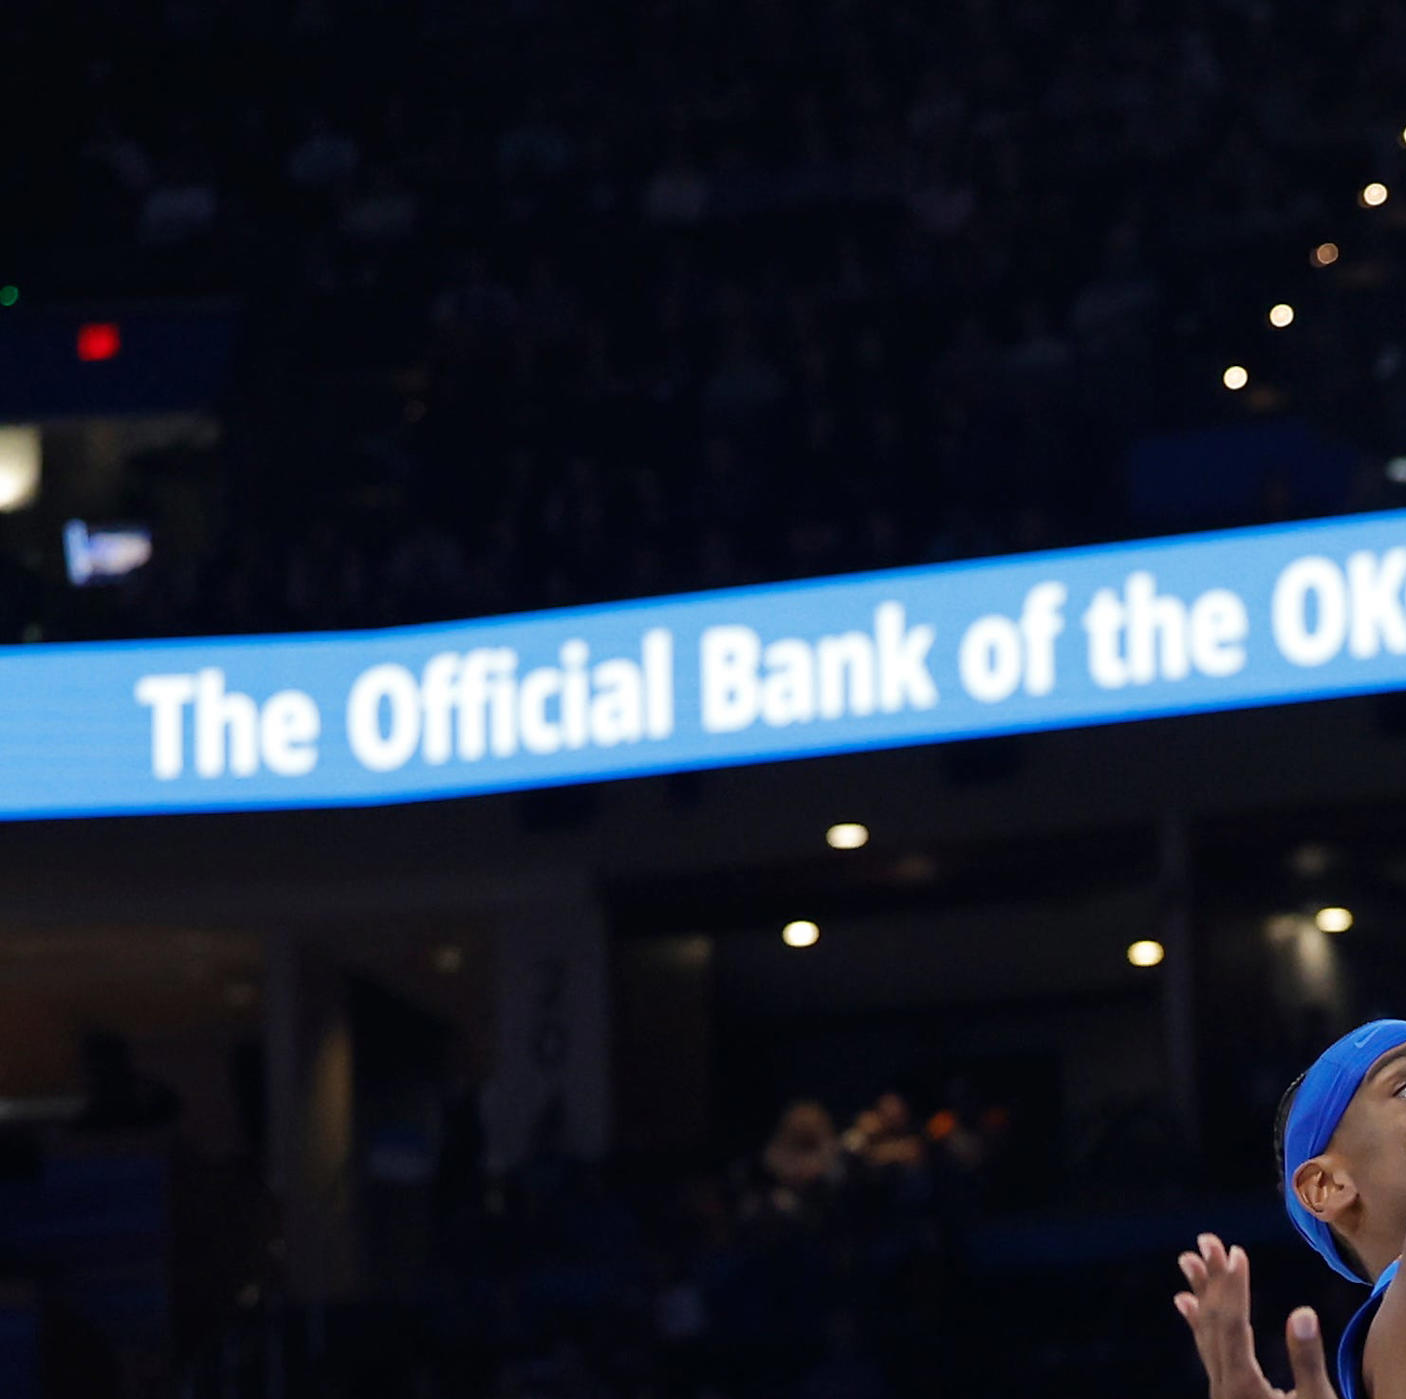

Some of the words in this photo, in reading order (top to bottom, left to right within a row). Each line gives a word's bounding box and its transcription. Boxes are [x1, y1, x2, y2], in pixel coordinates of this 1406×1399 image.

[136, 668, 318, 778] The
[347, 627, 672, 770] Official
[700, 602, 937, 731] Bank
[958, 582, 1068, 703] of
[1084, 570, 1248, 687] the
